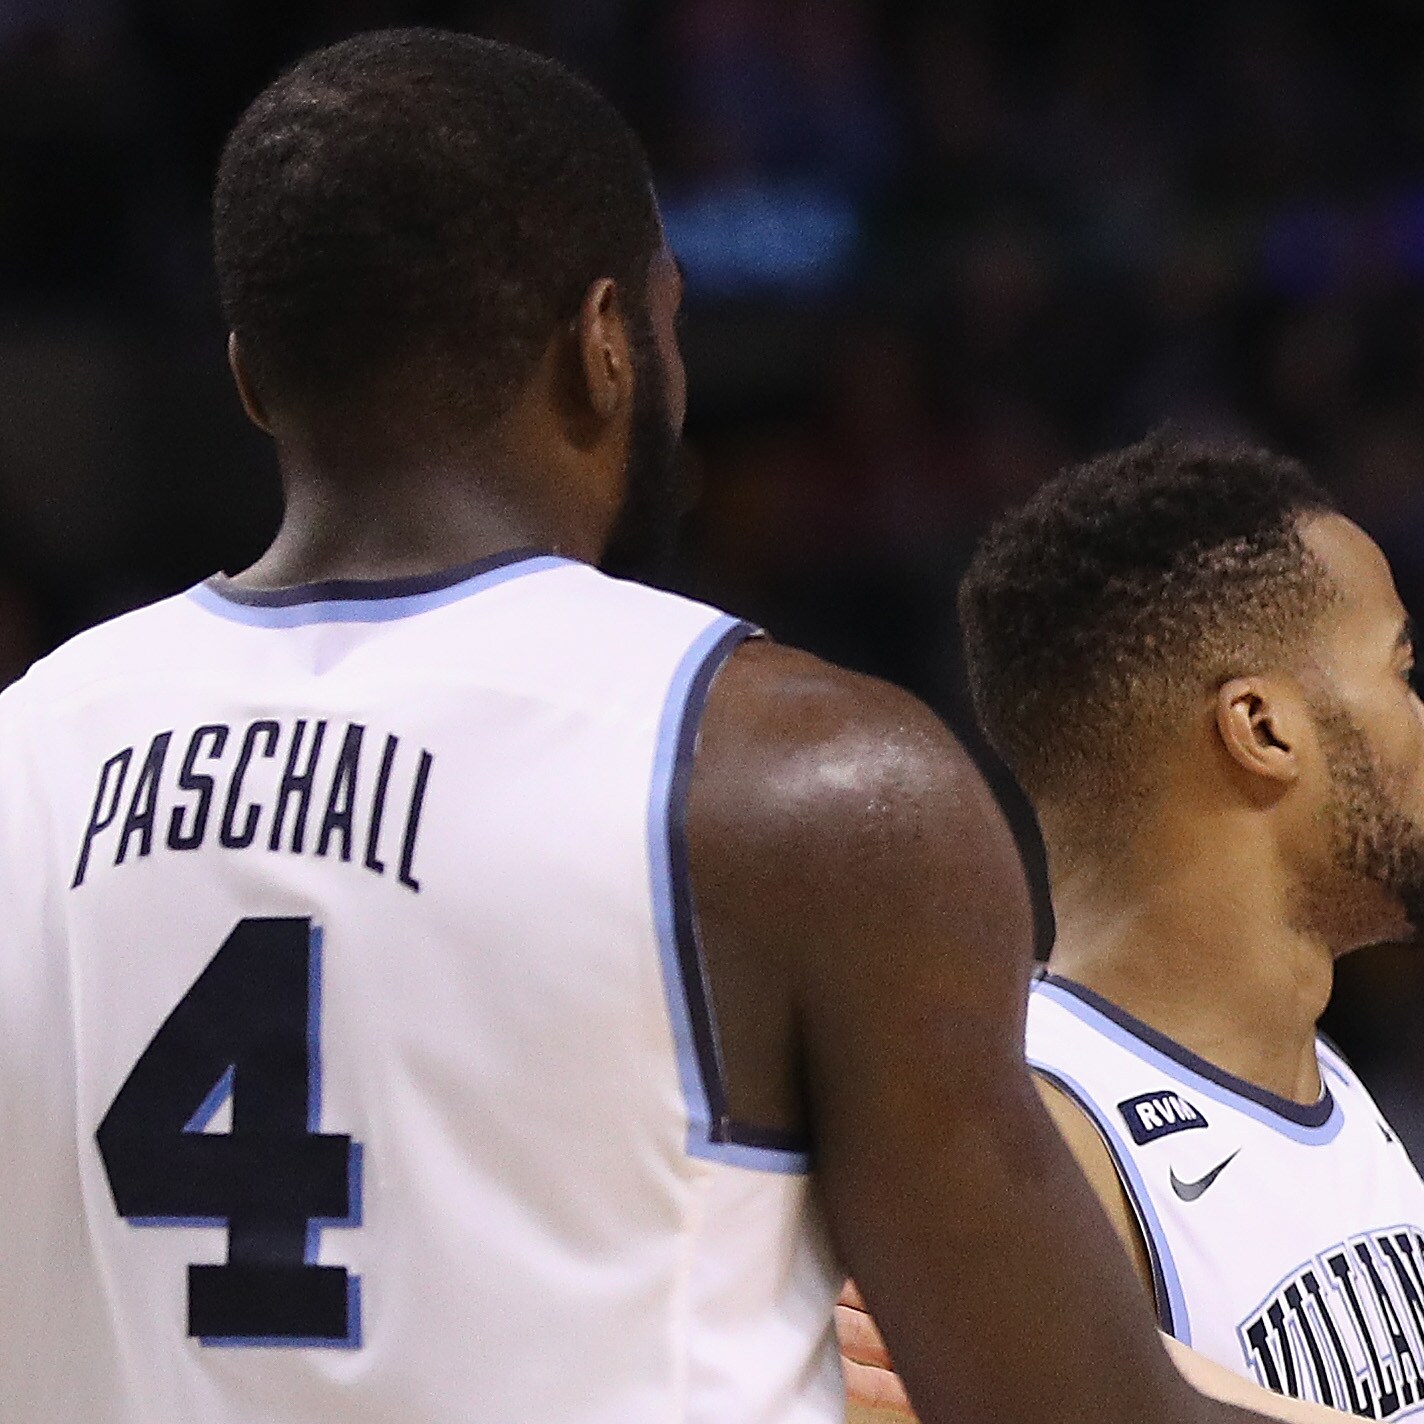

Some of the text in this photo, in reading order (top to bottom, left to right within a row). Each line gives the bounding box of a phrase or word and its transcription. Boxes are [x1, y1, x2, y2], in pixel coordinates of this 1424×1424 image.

[71, 720, 434, 891] PASCHALL
[96, 916, 363, 1349] 4
[1135, 1096, 1197, 1131] RVM
